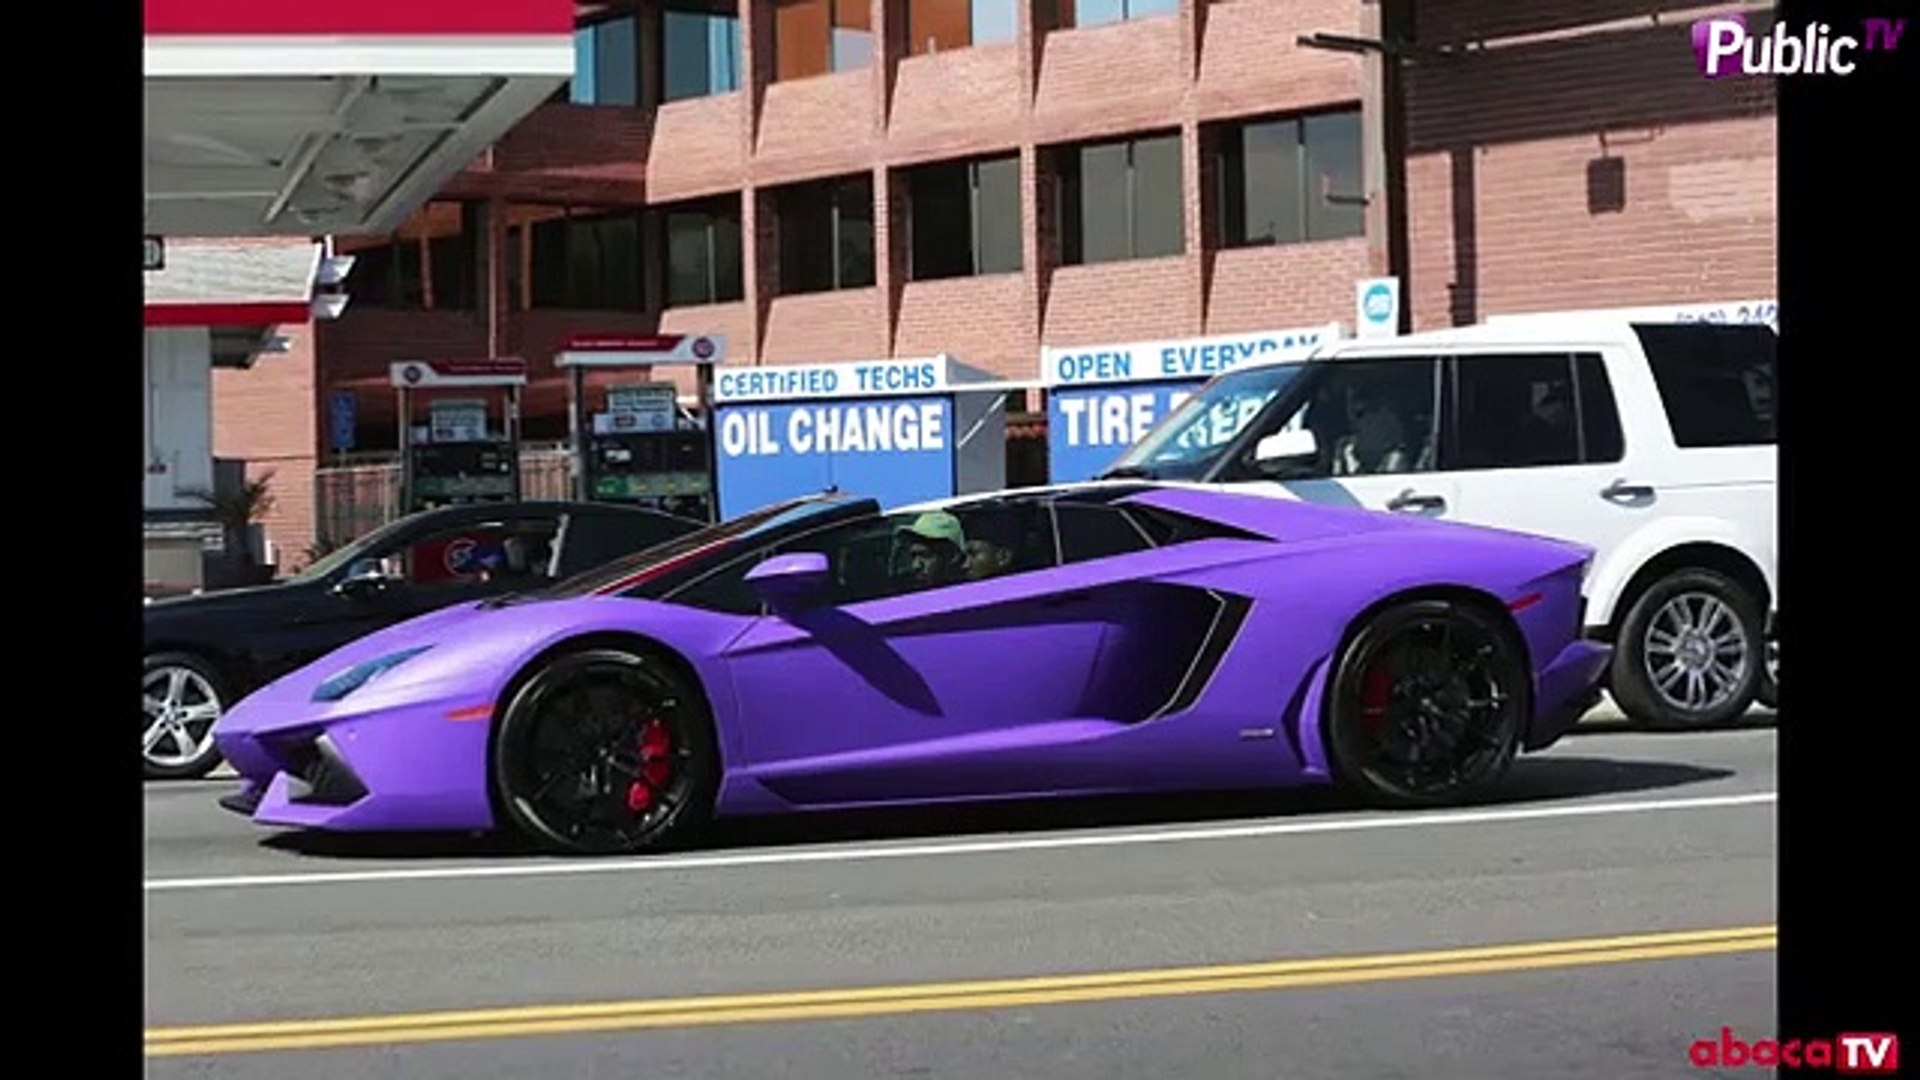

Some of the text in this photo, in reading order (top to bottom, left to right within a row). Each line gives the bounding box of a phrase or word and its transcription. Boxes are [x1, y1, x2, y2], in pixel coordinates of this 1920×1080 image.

[720, 364, 935, 396] CERTIFIED TECHS
[1058, 352, 1131, 380] OPEN
[722, 404, 944, 457] OIL CHANGE
[1059, 392, 1154, 446] TIRE
